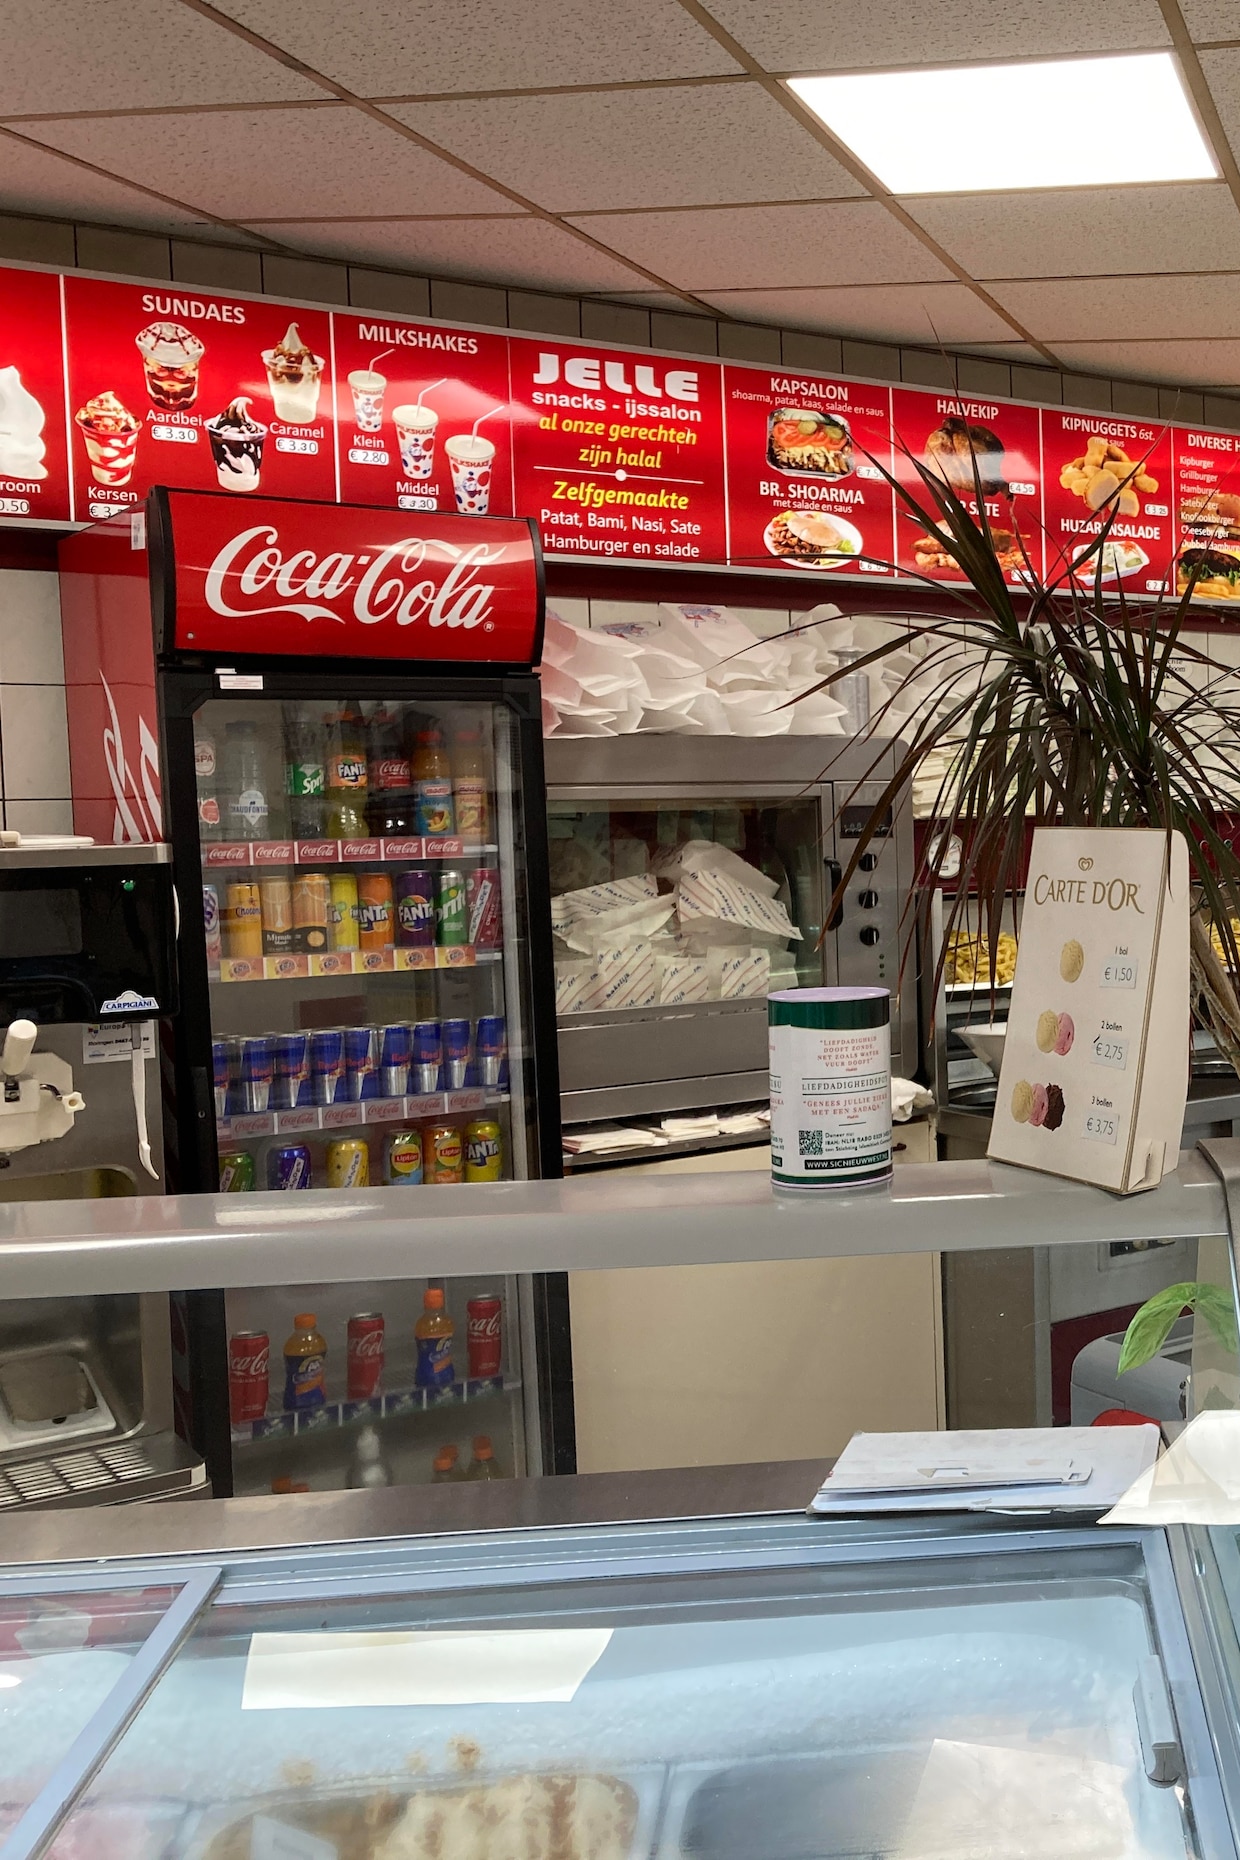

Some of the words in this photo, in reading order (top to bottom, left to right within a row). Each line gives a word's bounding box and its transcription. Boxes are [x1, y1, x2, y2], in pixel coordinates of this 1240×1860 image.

[142, 295, 245, 324] SUNDAES
[358, 324, 478, 354] MILKSHAKES
[533, 353, 699, 402] JELLE
[770, 378, 848, 401] KAPSALON
[532, 391, 606, 411] snacks
[625, 402, 701, 422] ijssalon
[732, 390, 772, 405] shoarma,
[775, 396, 799, 409] patat,
[802, 398, 823, 411] kaas,
[826, 400, 853, 413] salade
[855, 406, 864, 415] en
[866, 407, 884, 417] saus
[937, 400, 999, 420] HALVEKIP
[146, 409, 203, 426] Aardbei
[269, 423, 324, 438] Caramel
[539, 415, 557, 431] al
[562, 421, 605, 436] onze
[609, 423, 697, 445] gerechten
[1062, 416, 1137, 438] KIPNUGGETS
[353, 435, 385, 449] Klein
[1188, 434, 1232, 452] DIVERSE
[579, 446, 612, 467] zijn
[617, 450, 662, 468] halal
[1180, 456, 1214, 469] Kipburger
[1180, 470, 1218, 483] Grillburger
[88, 486, 138, 502] Kersen
[396, 481, 439, 496] Middel
[552, 482, 689, 509] Zelfgemaakte
[759, 481, 784, 497] BR.
[788, 484, 865, 505] SHOARMA
[773, 499, 790, 508] met
[793, 499, 820, 511] salade
[821, 503, 833, 511] en
[835, 503, 853, 514] saus
[969, 503, 1000, 517] STE
[541, 509, 583, 528] Patat,
[588, 513, 628, 532] Bami,
[632, 517, 666, 534] Nasi,
[670, 519, 701, 535] Sate
[544, 533, 628, 555] Hamburger
[633, 541, 650, 553] en
[654, 541, 700, 558] salade
[204, 525, 508, 630] Coca-Cola
[1034, 874, 1086, 906] CARTE
[1092, 878, 1145, 914] D'OR
[1120, 947, 1128, 956] bol
[1115, 967, 1133, 982] 1,50
[106, 1001, 152, 1010] CARPIGIANI
[1107, 1022, 1123, 1032] bollen
[1105, 1045, 1123, 1060] 2,75
[1096, 1098, 1113, 1108] bollen
[1096, 1120, 1113, 1136] 3,75
